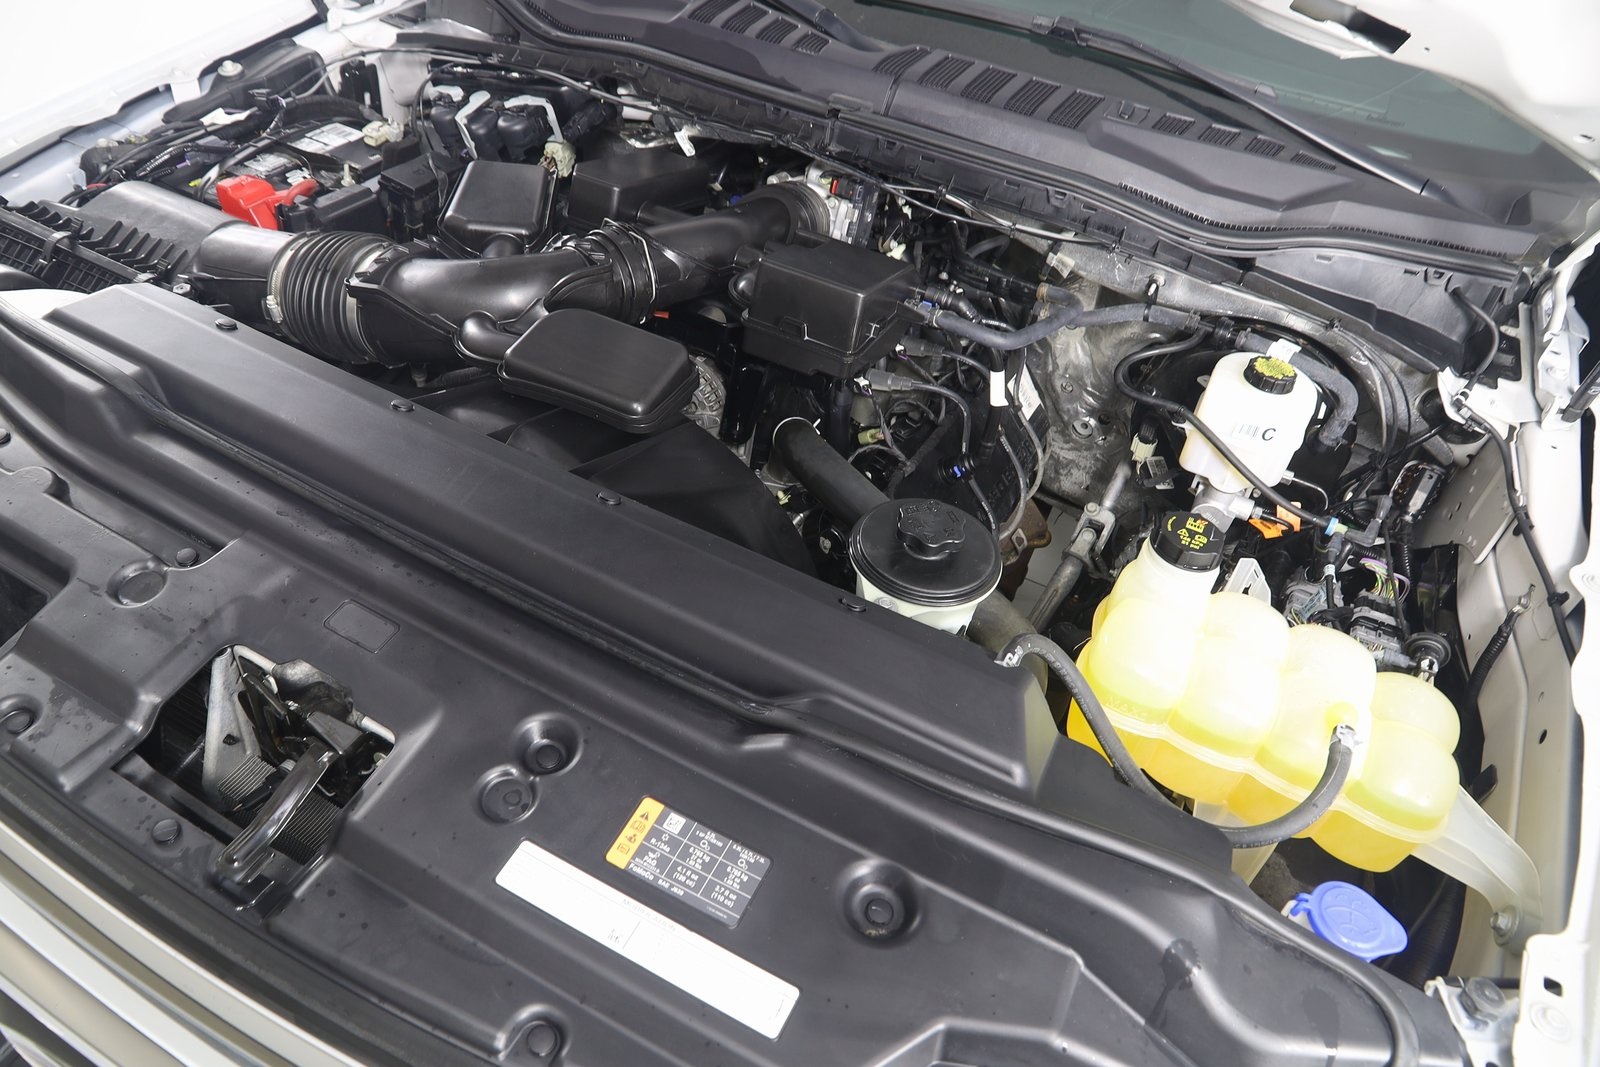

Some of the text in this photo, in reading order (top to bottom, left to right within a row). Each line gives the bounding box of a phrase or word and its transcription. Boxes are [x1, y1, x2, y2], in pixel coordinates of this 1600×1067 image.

[1262, 427, 1276, 441] C
[650, 837, 671, 853] R-134a
[628, 863, 655, 881] FoMoCo
